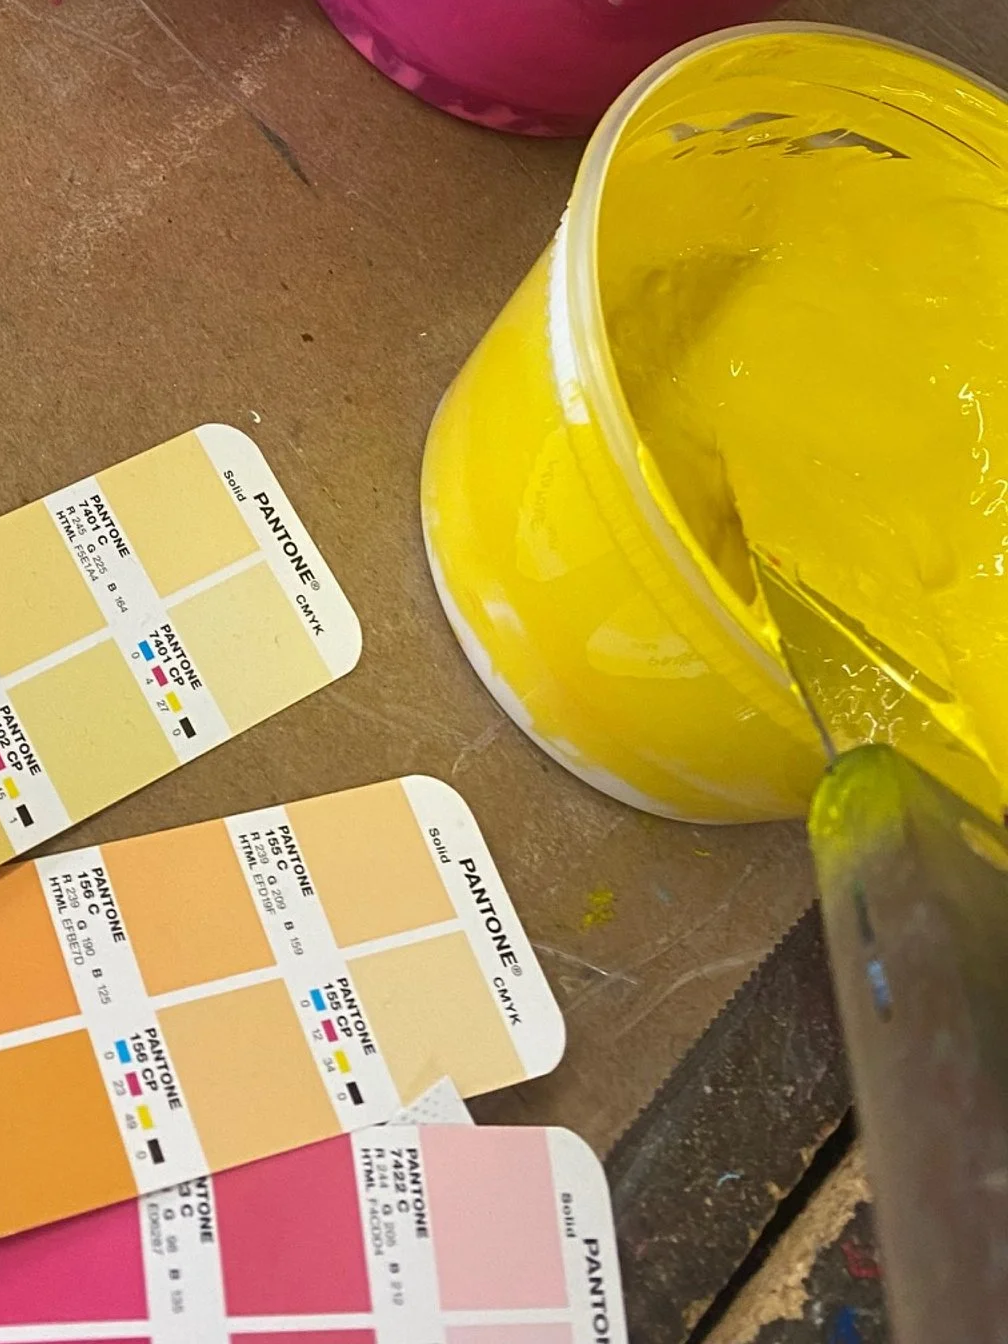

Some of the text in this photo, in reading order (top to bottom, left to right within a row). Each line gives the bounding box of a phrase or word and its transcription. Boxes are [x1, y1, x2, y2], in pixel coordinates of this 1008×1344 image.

[54, 509, 100, 583] HTML F5E1A4
[77, 498, 109, 547] 7401 C
[88, 493, 131, 559] PANTONE
[222, 469, 325, 637] Solid CMYK
[65, 504, 129, 614] R 245 G 225 B 164
[148, 628, 186, 687] 7401 CP
[159, 622, 203, 691] PANTONE
[129, 650, 182, 737] 0 4 27 0
[5, 749, 24, 772] CP
[237, 833, 258, 871] HTML
[264, 828, 289, 872] 155 C
[276, 824, 315, 898] PANTONE
[47, 875, 68, 915] HTML
[76, 870, 101, 916] 156 C
[90, 866, 127, 944] PANTONE
[249, 830, 305, 957] R 239 G 209 B 159
[427, 826, 522, 1026] Solid CMYK
[60, 872, 113, 1006] R 239 G 190 B 125
[322, 981, 354, 1038] 155 CP
[335, 976, 377, 1056] PANTONE
[128, 1032, 159, 1092] 156 CP
[143, 1026, 183, 1111] PANTONE
[360, 1147, 376, 1192] HTML
[389, 1148, 410, 1213] 7422 C
[404, 1147, 429, 1238] PANTONE
[560, 1191, 578, 1239] Solid
